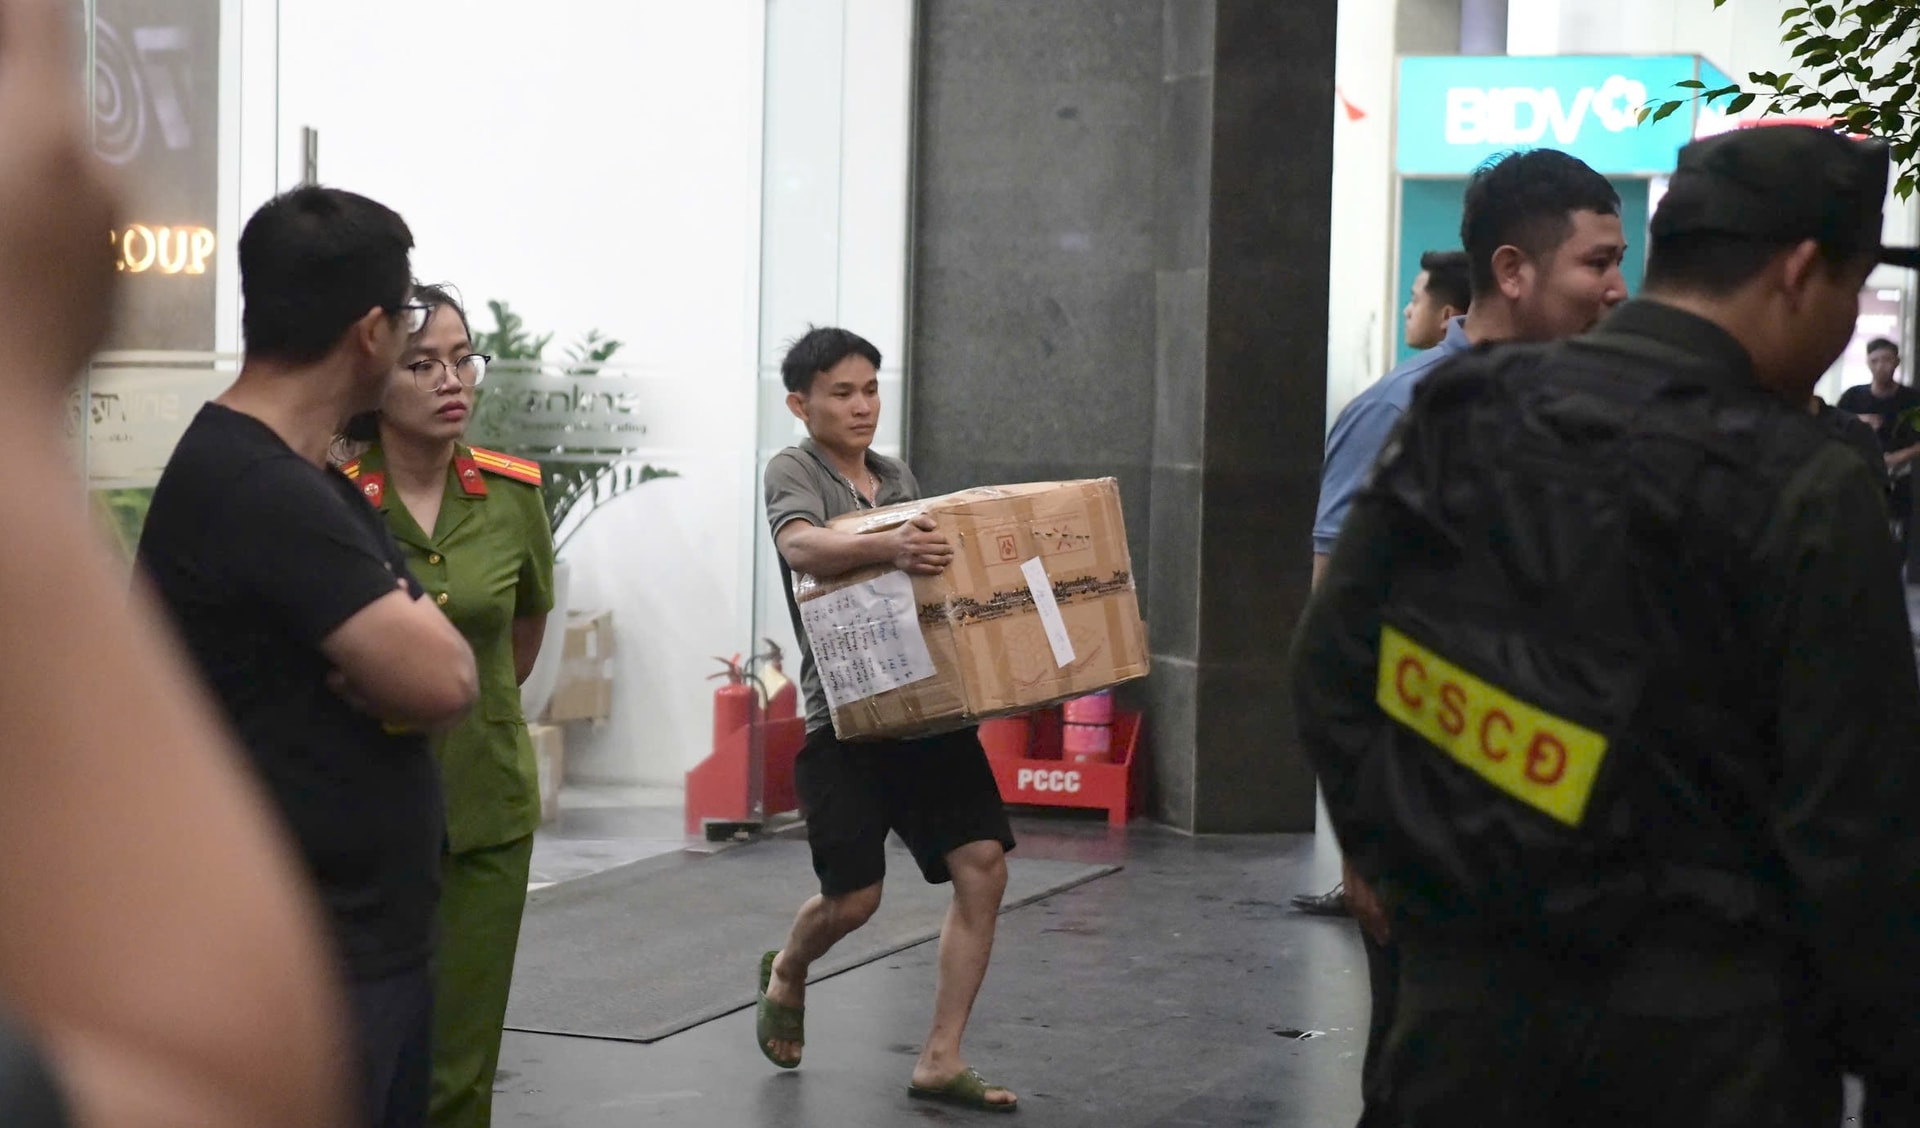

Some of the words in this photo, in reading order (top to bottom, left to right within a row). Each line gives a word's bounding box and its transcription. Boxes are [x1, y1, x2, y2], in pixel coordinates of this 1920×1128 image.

[1446, 87, 1595, 144] BIDV
[111, 224, 215, 274] OUP
[1395, 655, 1567, 786] CSCĐ
[1017, 769, 1080, 793] PCCC
